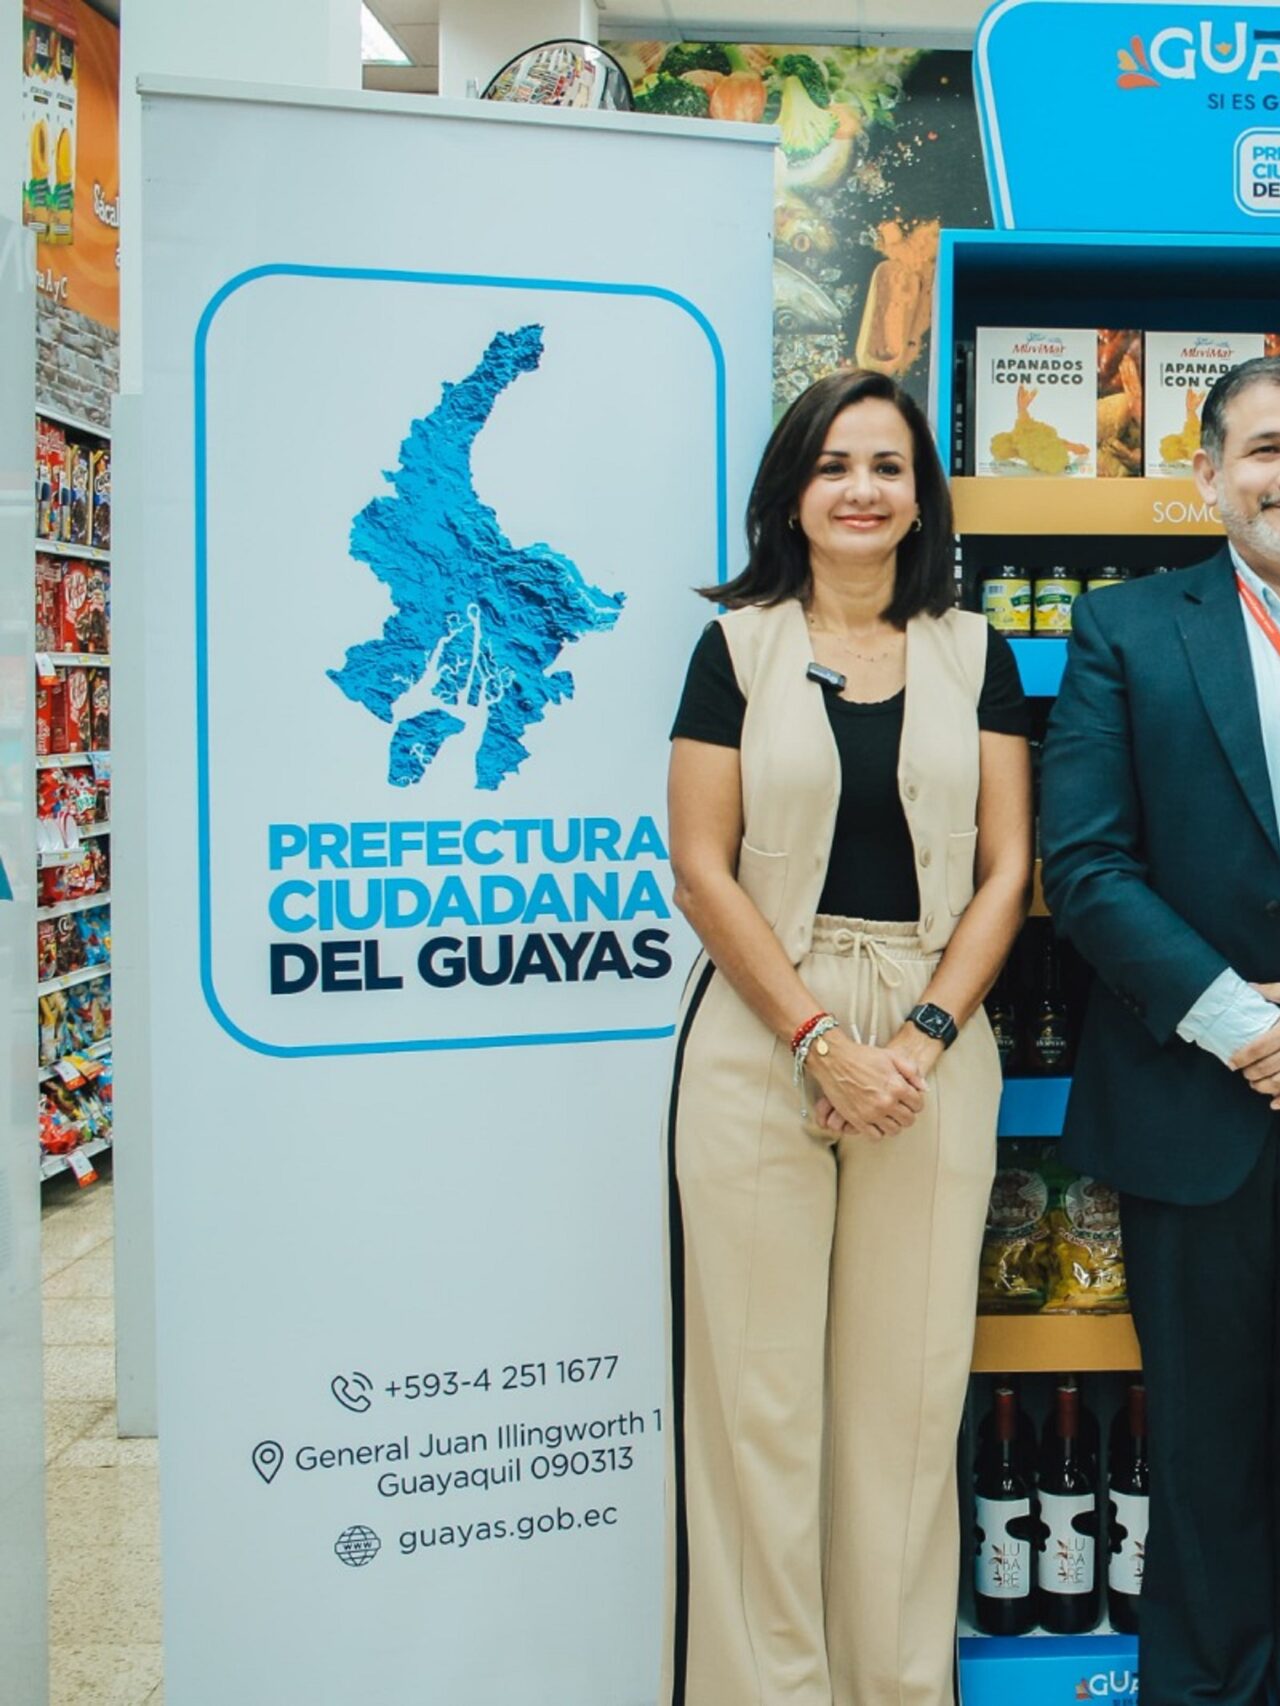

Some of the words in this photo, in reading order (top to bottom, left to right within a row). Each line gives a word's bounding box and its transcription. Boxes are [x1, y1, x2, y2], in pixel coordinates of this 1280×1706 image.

[1208, 93, 1224, 110] SI
[1228, 94, 1255, 111] ES
[996, 373, 1031, 384] CON
[1036, 374, 1083, 385] COCO
[997, 359, 1083, 370] APANADOS
[1165, 376, 1199, 387] CON
[269, 816, 668, 870] PREFECTURA
[268, 870, 671, 933] CIUDADANA
[270, 940, 403, 995] DEL
[418, 929, 672, 988] GUAYAS
[385, 1368, 491, 1400] +593-4
[502, 1363, 547, 1390] 251
[557, 1355, 618, 1385] 1677
[296, 1436, 408, 1471] General
[419, 1431, 487, 1459] Juan
[498, 1411, 645, 1450] Illingworth
[653, 1409, 663, 1432] 1
[377, 1459, 521, 1498] Guayaquil
[531, 1446, 633, 1479] 090313
[399, 1506, 617, 1555] guayas.gob.ec
